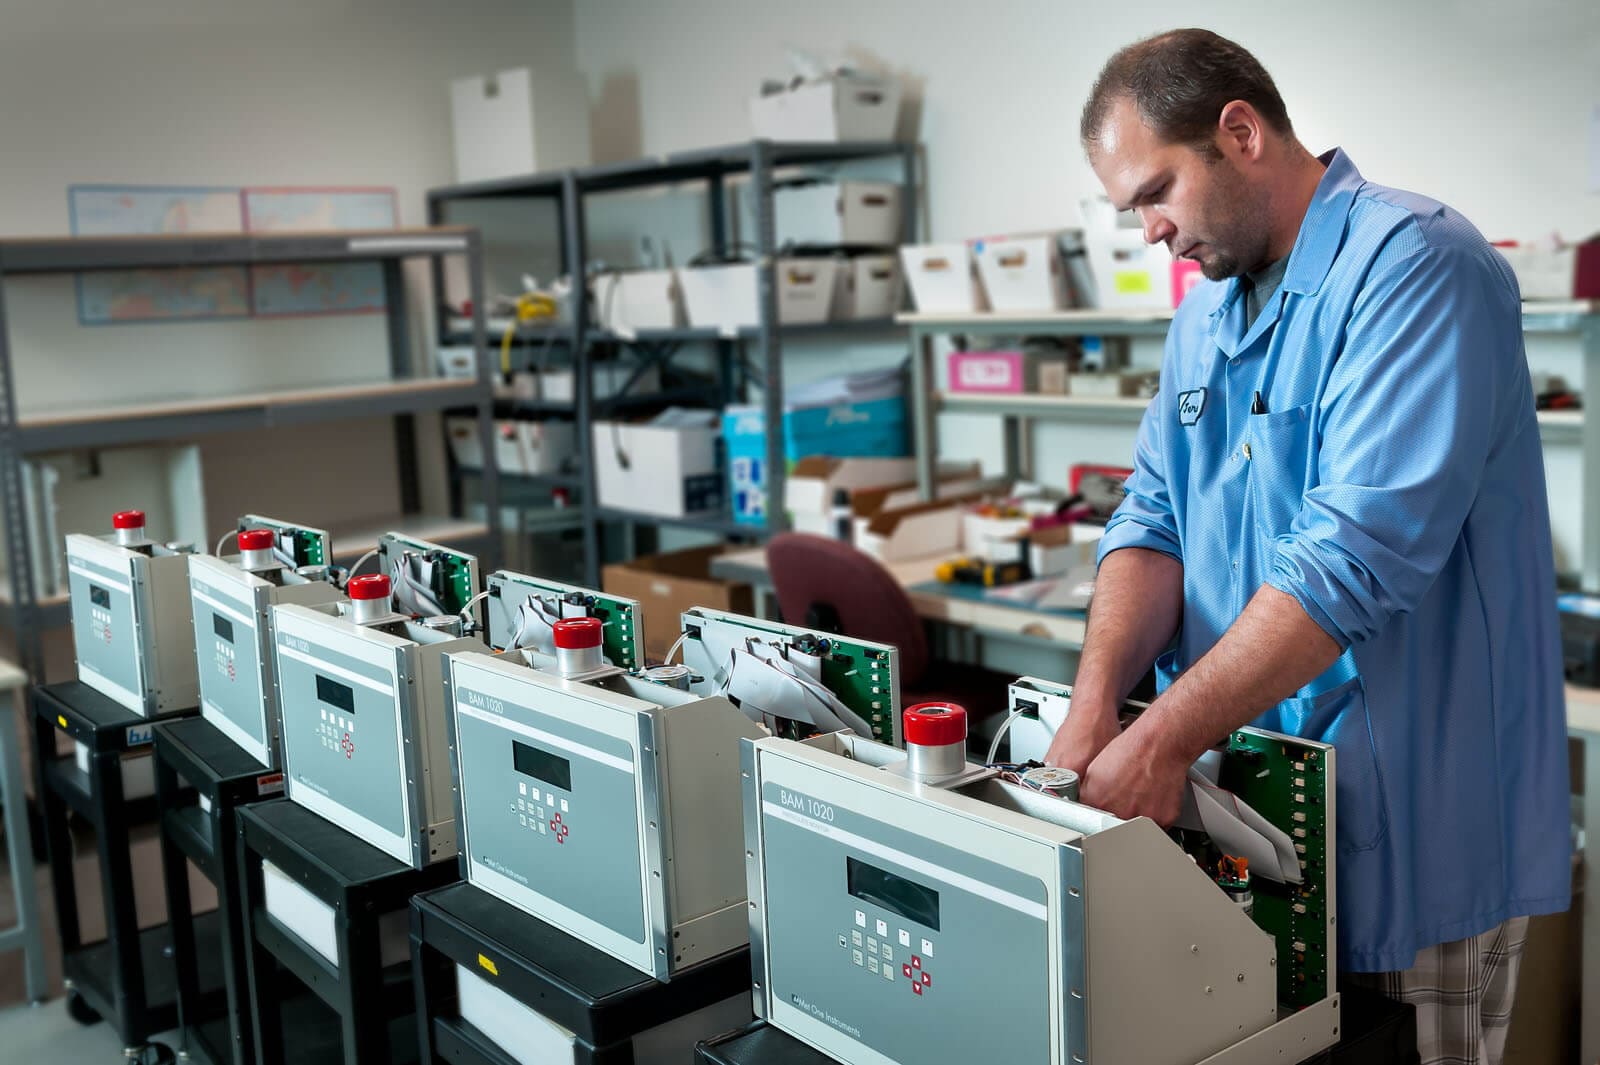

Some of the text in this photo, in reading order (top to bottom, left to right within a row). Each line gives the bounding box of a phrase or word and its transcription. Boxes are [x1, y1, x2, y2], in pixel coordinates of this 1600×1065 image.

[468, 691, 504, 714] BAM 1020
[780, 789, 805, 812] BAM
[807, 799, 834, 822] 1020
[799, 998, 861, 1038] Met One Instruments
